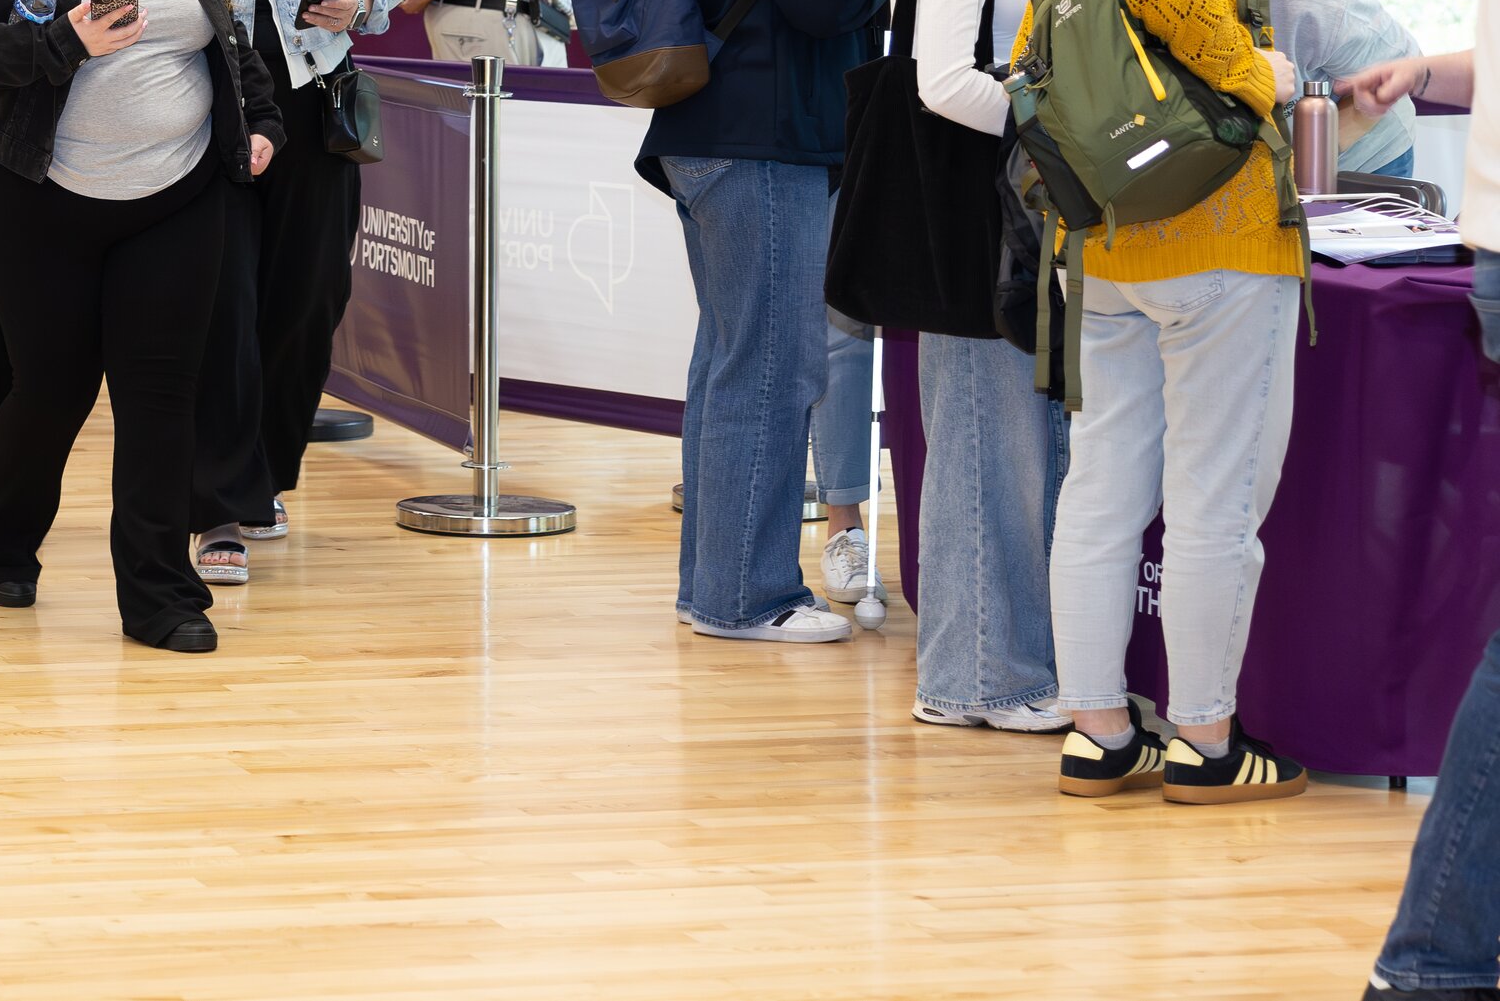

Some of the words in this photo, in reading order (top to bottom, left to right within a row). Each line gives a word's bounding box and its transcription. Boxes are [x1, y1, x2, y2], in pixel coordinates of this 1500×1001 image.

[362, 205, 425, 249] UNIVERSITY
[423, 229, 436, 252] OF
[362, 238, 435, 288] PORTSMOUTH
